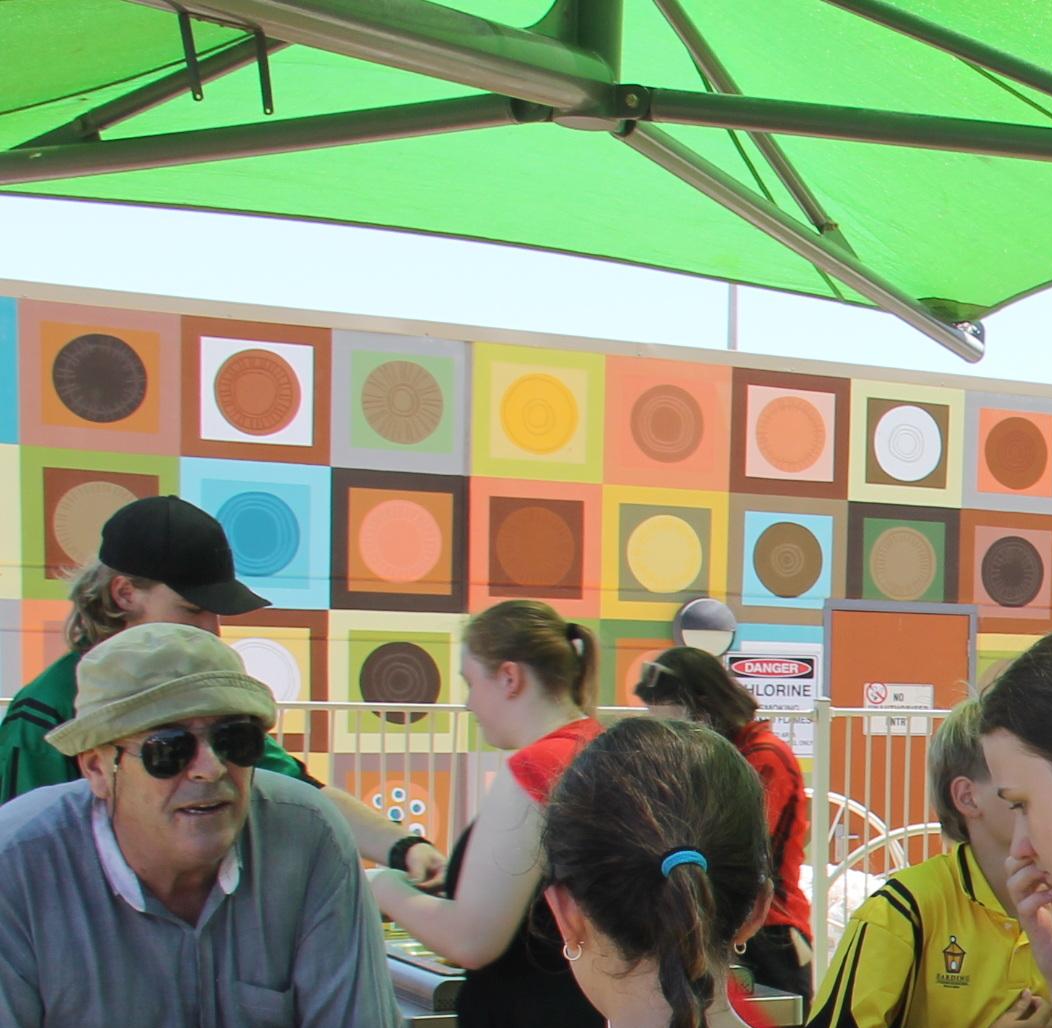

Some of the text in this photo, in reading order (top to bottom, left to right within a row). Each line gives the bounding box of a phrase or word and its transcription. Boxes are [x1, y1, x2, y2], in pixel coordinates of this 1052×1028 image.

[744, 662, 799, 674] DANGER
[744, 684, 812, 697] HLORINE
[893, 692, 905, 702] NO
